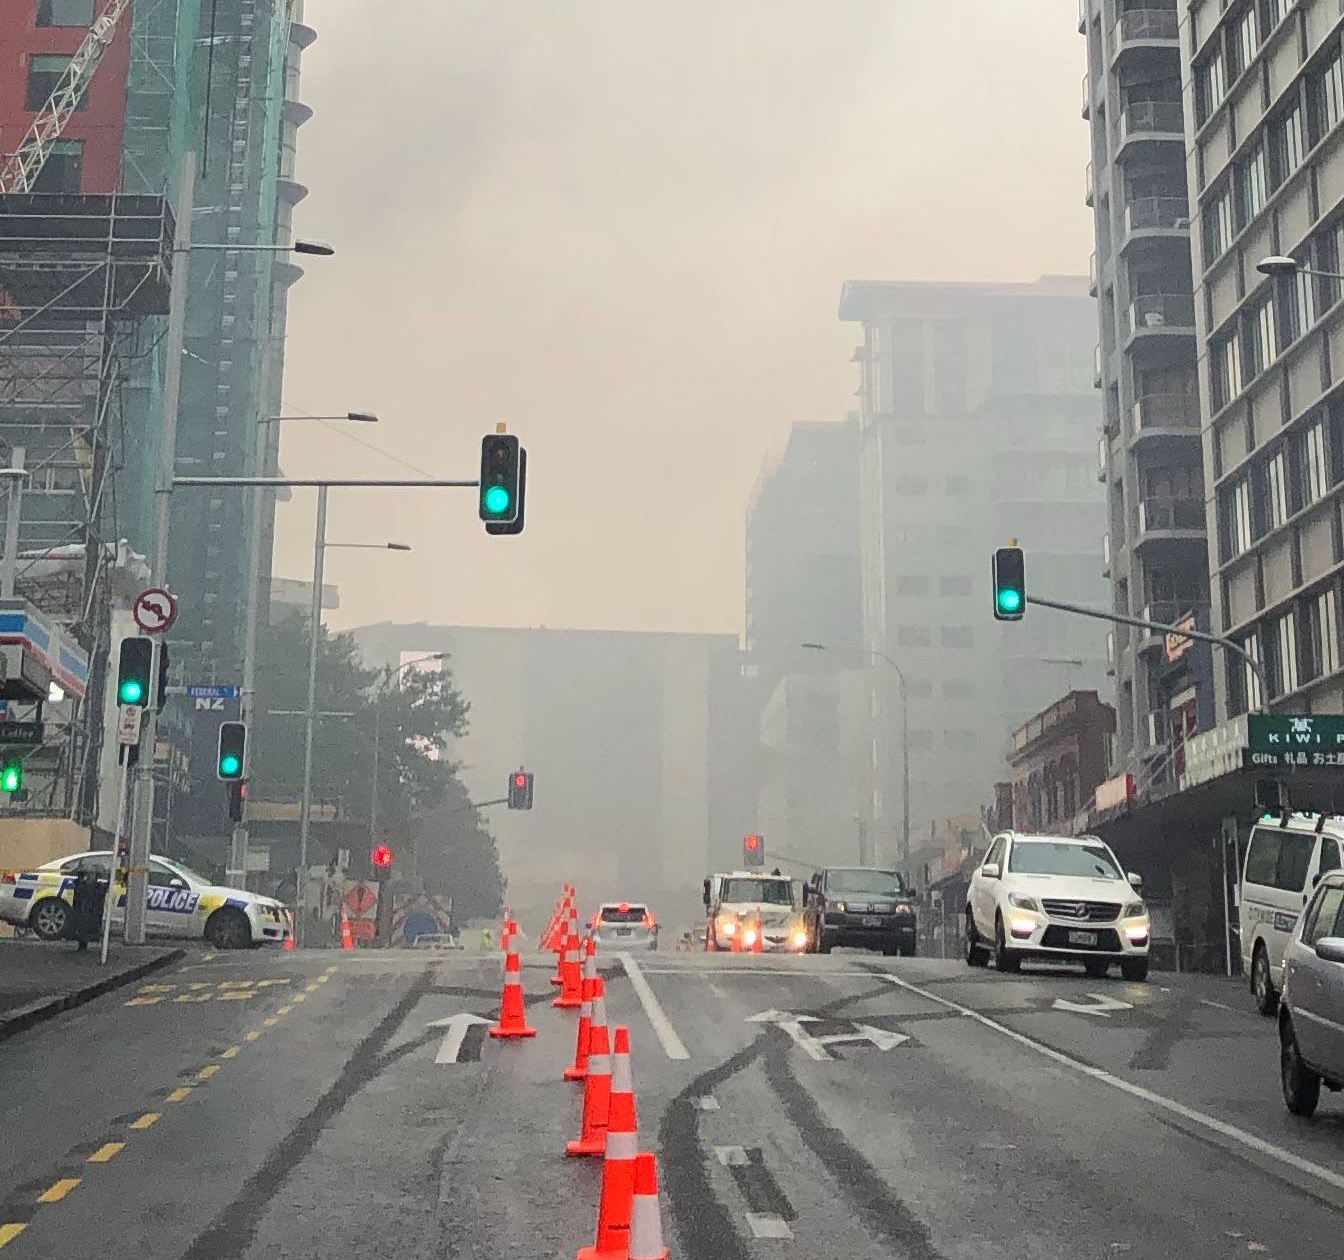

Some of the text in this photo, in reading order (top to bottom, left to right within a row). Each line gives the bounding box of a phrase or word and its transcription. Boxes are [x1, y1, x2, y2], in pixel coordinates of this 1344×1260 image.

[195, 698, 225, 710] NZ
[1269, 733, 1320, 744] KIWI
[146, 889, 198, 911] POLICE
